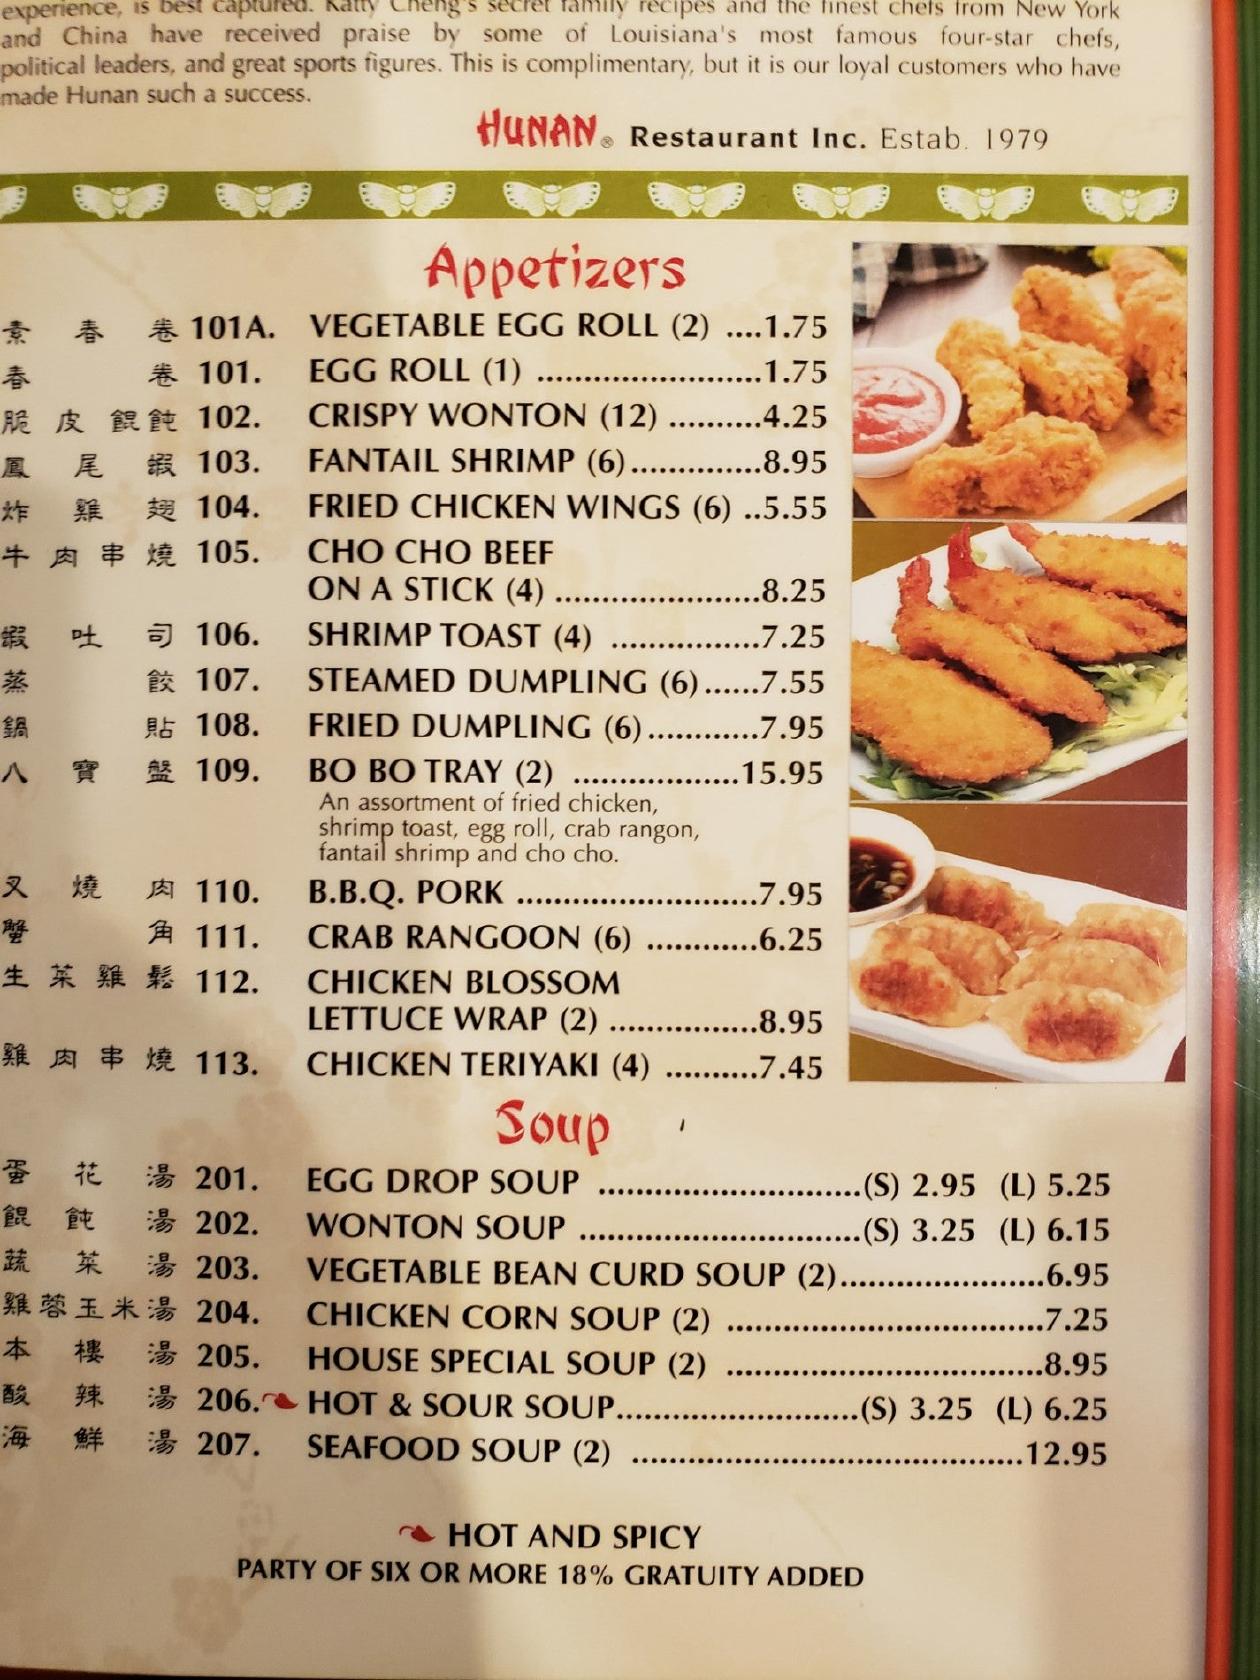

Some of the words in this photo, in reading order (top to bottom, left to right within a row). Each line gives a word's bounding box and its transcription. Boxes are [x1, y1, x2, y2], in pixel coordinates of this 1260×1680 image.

[2, 1, 122, 24] experience,
[1016, 0, 1066, 18] New
[1075, 0, 1120, 20] York
[2, 27, 41, 48] and
[63, 25, 127, 45] China
[151, 24, 203, 43] have
[225, 22, 321, 43] received
[343, 24, 411, 49] praise
[433, 22, 461, 48] by
[483, 27, 543, 43] some
[611, 24, 737, 44] Louisiana's
[760, 27, 813, 44] most
[837, 24, 917, 45] famous
[942, 25, 1034, 46] four-star
[1056, 26, 1120, 51] chefs,
[1, 54, 85, 81] political
[94, 52, 176, 76] leaders,
[185, 52, 225, 73] and
[233, 55, 286, 80] great
[293, 55, 357, 79] sports
[364, 51, 442, 79] figures.
[450, 51, 494, 72] This
[525, 53, 695, 80] complimentary,
[704, 53, 739, 74] but
[793, 59, 830, 74] our
[839, 54, 889, 81] loyal
[897, 57, 1008, 76] customers
[1015, 56, 1063, 77] who
[1071, 56, 1121, 78] have
[1, 84, 58, 106] made
[66, 85, 139, 105] Hunan
[146, 82, 196, 104] such
[224, 87, 312, 104] success.
[477, 108, 598, 148] HUNAN
[629, 126, 799, 149] Restaurant
[812, 127, 867, 149] Inc.
[881, 126, 968, 150] Estab.
[987, 127, 1049, 151] 1979
[424, 242, 686, 299] Appetizers
[191, 315, 275, 340] 101A.
[310, 313, 484, 338] VEGETABLE
[498, 312, 563, 338] EGG
[578, 312, 659, 338] ROLL
[672, 313, 709, 341] (2)
[310, 358, 376, 383] EGG
[391, 358, 470, 383] ROLL
[309, 402, 418, 428] CRISPY
[428, 402, 587, 428] WONTON
[600, 403, 658, 432] (12)
[309, 448, 439, 473] FANTAIL
[451, 448, 576, 473] SHRIMP
[197, 494, 259, 519] 104.
[309, 494, 398, 518] FRIED
[411, 494, 556, 519] CHICKEN
[567, 494, 680, 520] WINGS
[693, 495, 731, 524] (6)
[308, 539, 384, 564] CHO
[395, 539, 471, 565] CHO
[484, 540, 554, 565] BEEF
[308, 576, 361, 601] ON
[404, 576, 495, 602] STICK
[507, 578, 544, 607] (4)
[308, 622, 431, 647] SHRIMP
[440, 623, 542, 648] TOAST
[308, 667, 456, 692] STEAMED
[468, 668, 647, 694] DUMPLING
[309, 713, 399, 738] FRIED
[412, 714, 591, 739] DUMPLING
[196, 758, 259, 782] 109.
[310, 758, 356, 783] BO
[369, 759, 417, 783] BO
[424, 759, 503, 784] TRAY
[516, 760, 554, 788] (2)
[318, 791, 349, 811] An
[358, 795, 477, 812] assortment
[483, 791, 506, 812] of
[512, 791, 561, 813] fried
[568, 791, 658, 817] chicken,
[319, 816, 395, 843] shrimp
[401, 819, 459, 840] toast,
[467, 822, 506, 843] egg
[514, 817, 555, 840] roll,
[564, 818, 611, 838] crab
[619, 823, 700, 843] rangon,
[319, 841, 386, 862] fantail
[394, 842, 470, 867] shrimp
[477, 841, 518, 863] and
[525, 842, 566, 863] cho
[573, 843, 619, 863] cho.
[309, 879, 404, 910] B.B.Q.
[417, 880, 504, 904] PORK
[308, 924, 394, 949] CRAB
[406, 924, 580, 950] RANGOON
[308, 969, 453, 994] CHICKEN
[466, 970, 620, 995] BLOSSOM
[308, 1006, 443, 1031] LETTUCE
[454, 1006, 548, 1031] WRAP
[196, 1050, 258, 1076] 113.
[307, 1051, 451, 1076] CHICKEN
[461, 1052, 599, 1077] TERIYAKI
[496, 1099, 609, 1155] Soup
[308, 1168, 374, 1193] EGG
[386, 1168, 479, 1194] DROP
[490, 1169, 580, 1195] SOUP
[912, 1173, 976, 1198] 2.95
[1000, 1172, 1036, 1201] (L)
[1048, 1173, 1110, 1198] 5.25
[307, 1212, 463, 1239] WONTON
[476, 1214, 566, 1240] SOUP
[911, 1218, 975, 1242] 3.25
[1000, 1217, 1035, 1246] (L)
[1047, 1217, 1110, 1242] 6.15
[197, 1256, 258, 1280] 203.
[307, 1257, 481, 1285] VEGETABLE
[494, 1260, 577, 1287] BEAN
[589, 1261, 684, 1287] CURD
[697, 1262, 786, 1288] SOUP
[307, 1302, 450, 1329] CHICKEN
[462, 1304, 558, 1331] CORN
[570, 1306, 660, 1332] SOUP
[308, 1346, 418, 1373] HOUSE
[431, 1348, 555, 1375] SPECIAL
[567, 1350, 656, 1376] SOUP
[198, 1387, 260, 1413] 206.
[309, 1390, 379, 1416] HOT
[423, 1392, 515, 1419] SOUR
[525, 1394, 614, 1420] SOUP
[909, 1396, 973, 1421] 3.25
[996, 1395, 1032, 1425] (L)
[1045, 1396, 1107, 1421] 6.25
[308, 1434, 461, 1461] SEAFOOD
[472, 1437, 562, 1463] SOUP
[449, 1522, 518, 1548] HOT
[527, 1523, 601, 1549] AND
[613, 1524, 702, 1549] SPICY
[237, 1558, 317, 1580] PARTY
[325, 1559, 363, 1581] OF
[371, 1561, 410, 1582] SIX
[419, 1561, 461, 1584] OR
[469, 1562, 547, 1584] MORE
[557, 1563, 613, 1586] 18%
[624, 1564, 759, 1587] GRATUITY
[767, 1565, 865, 1588] ADDED
